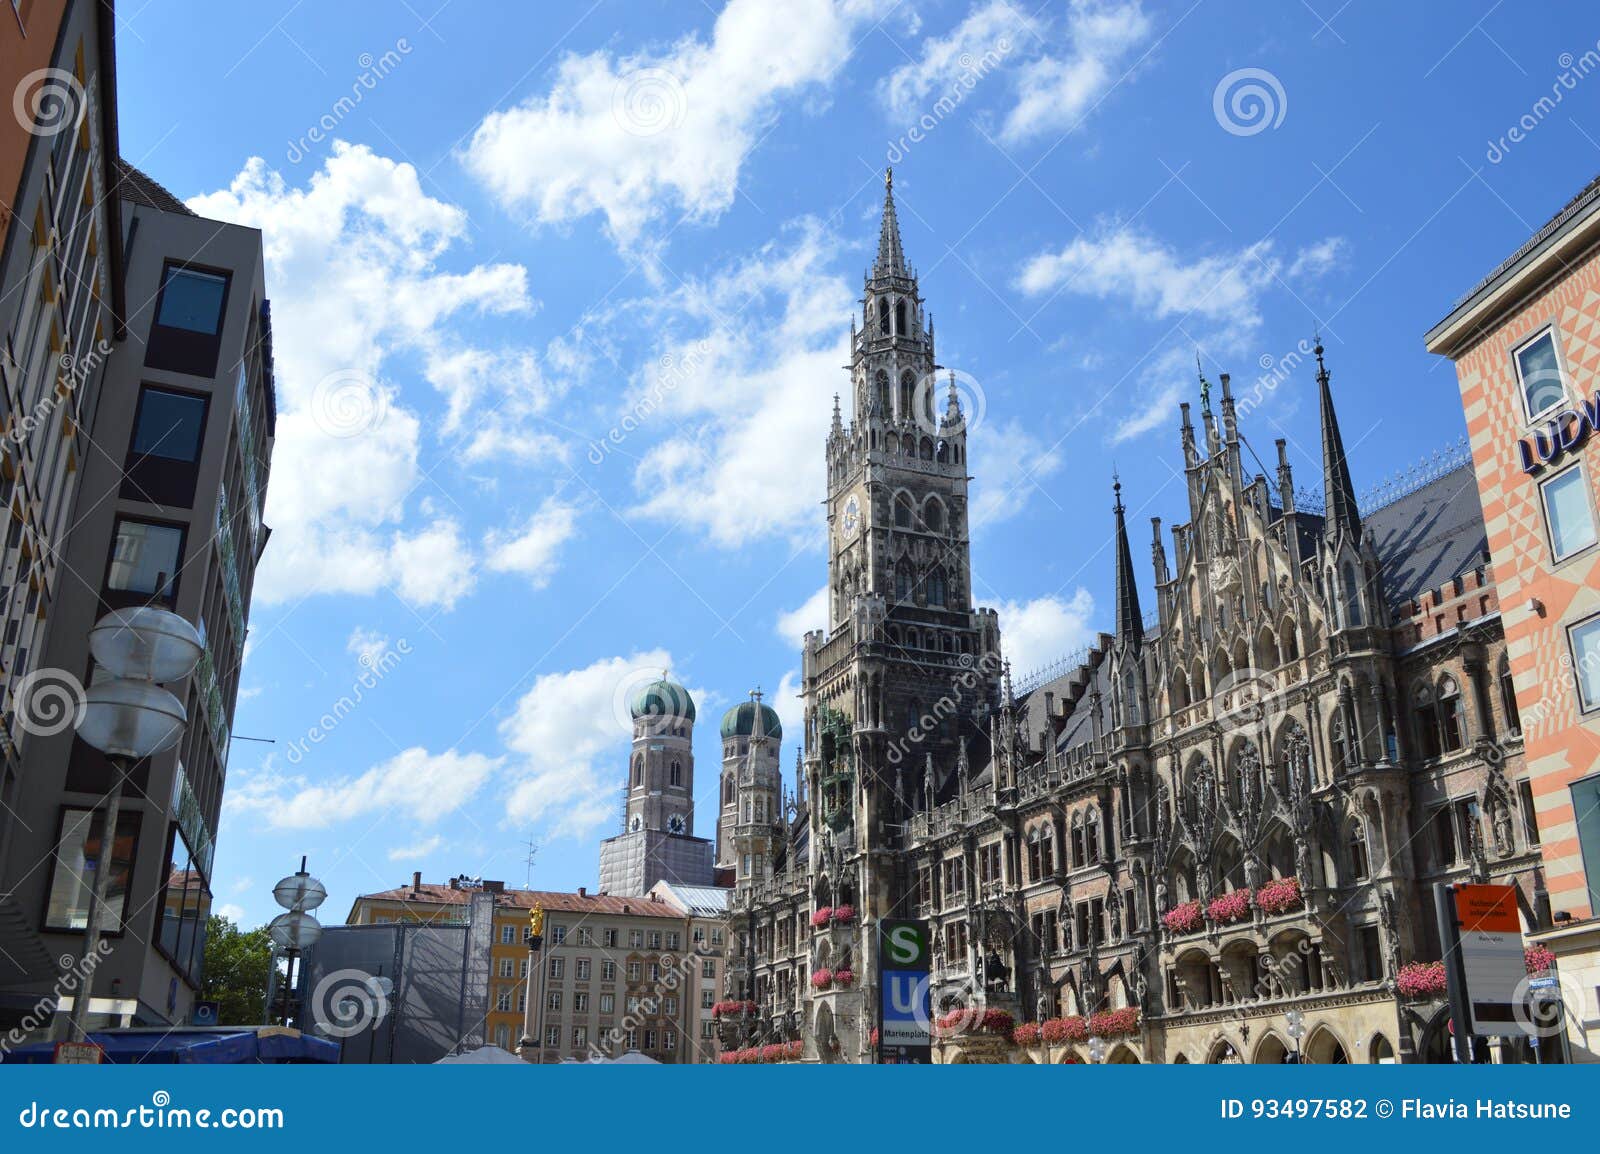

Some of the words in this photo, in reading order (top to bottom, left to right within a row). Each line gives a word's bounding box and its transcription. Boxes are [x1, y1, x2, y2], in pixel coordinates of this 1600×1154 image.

[891, 926, 920, 963] S
[891, 976, 919, 1014] U
[884, 1029, 929, 1039] Marienplatz
